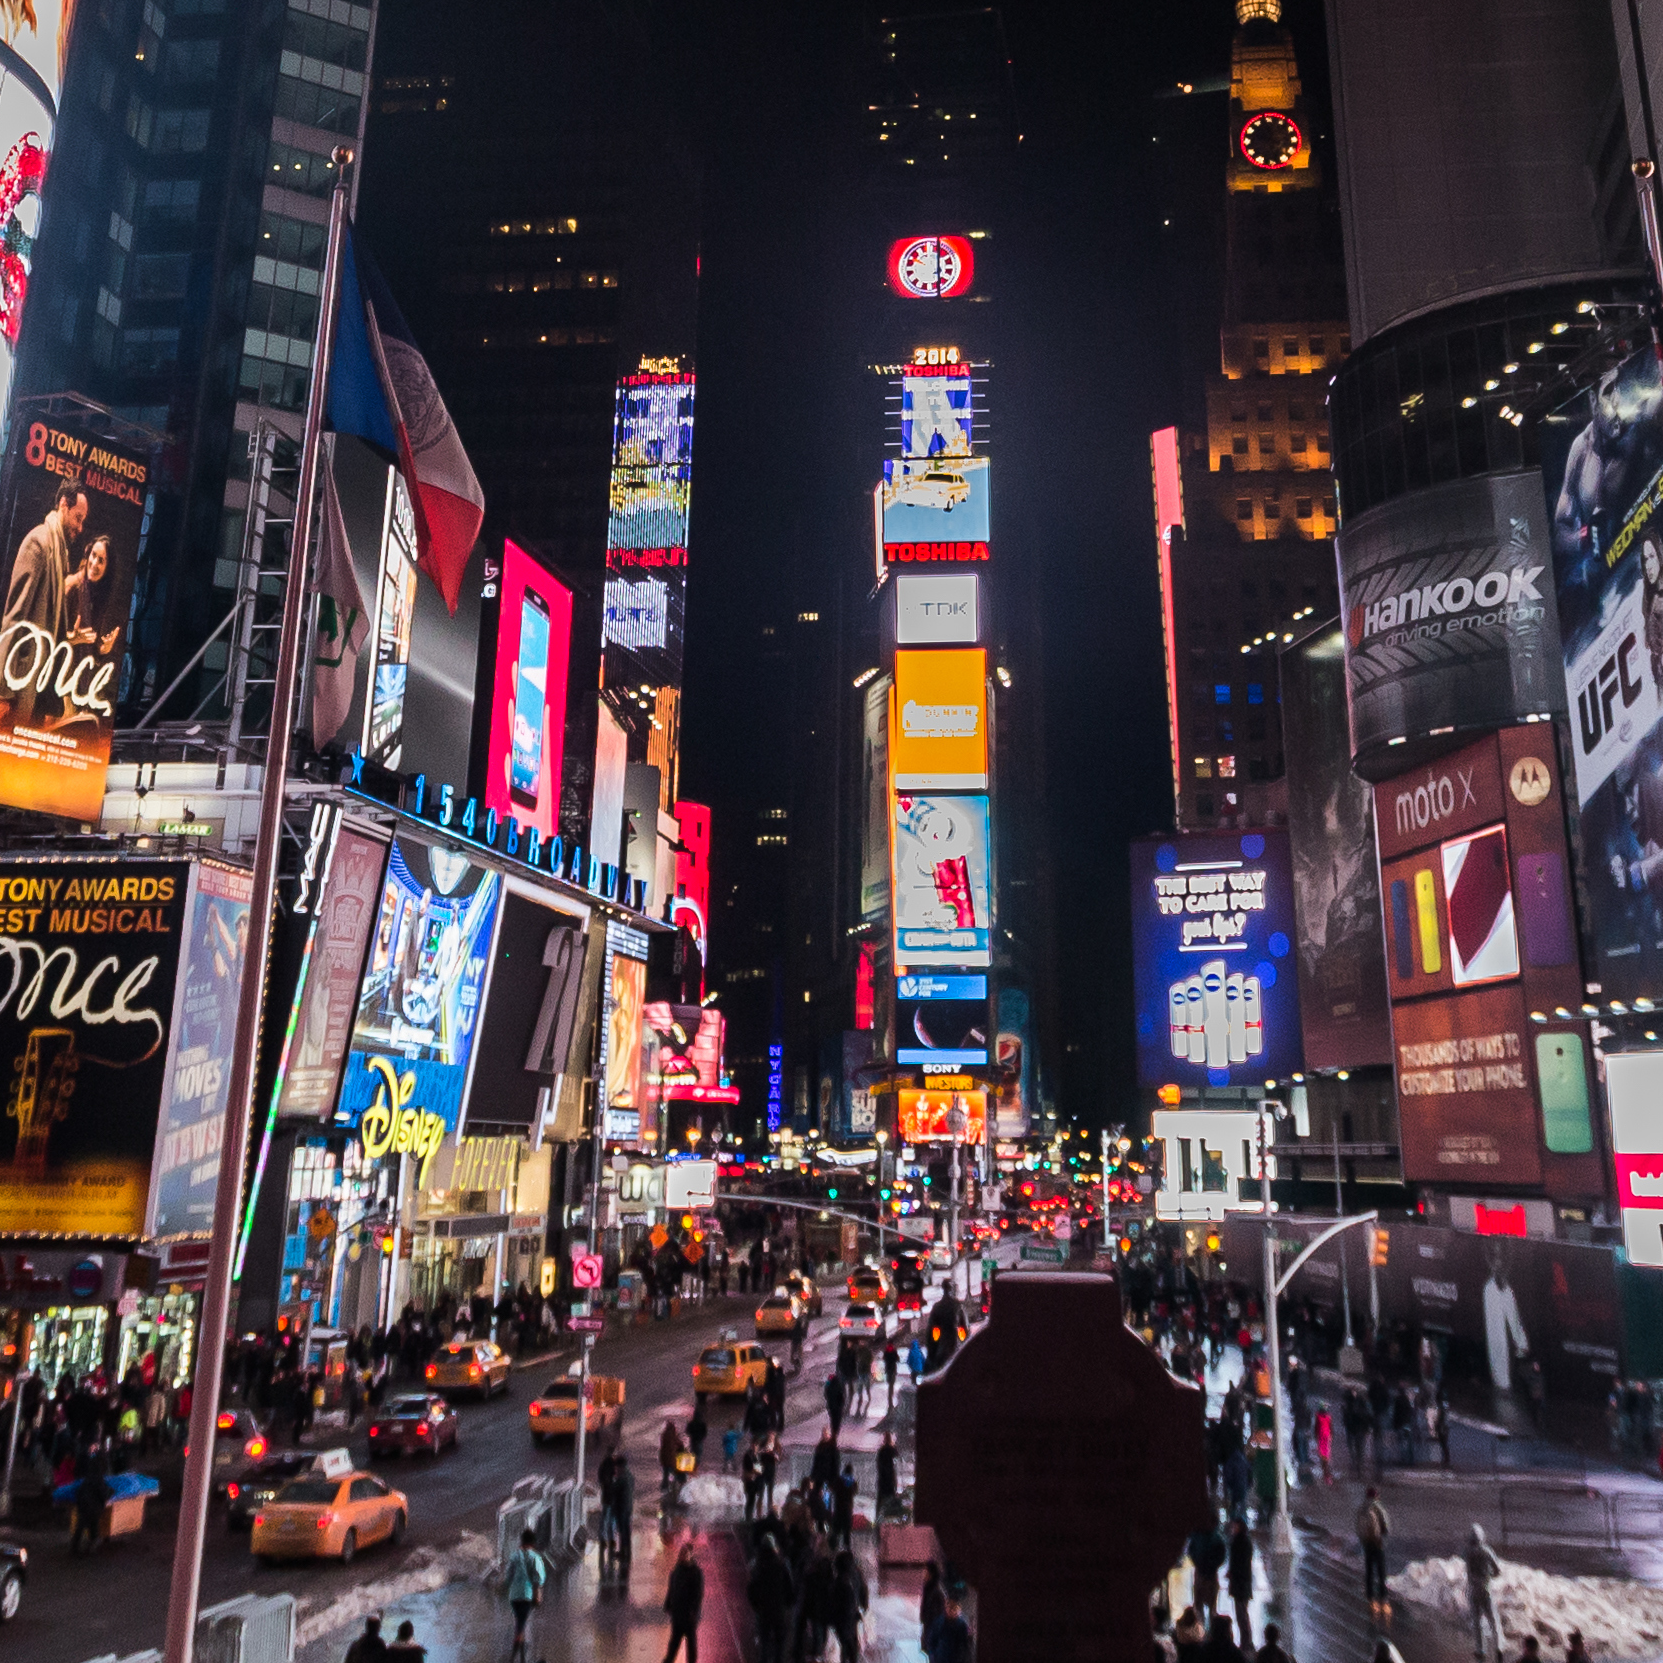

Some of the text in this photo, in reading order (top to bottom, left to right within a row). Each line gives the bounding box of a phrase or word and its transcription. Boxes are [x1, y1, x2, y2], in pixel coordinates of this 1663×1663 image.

[904, 365, 970, 376] TOSHIBA
[914, 350, 958, 365] 2014
[25, 422, 147, 483] 8 TONY AWARDS
[45, 456, 143, 506] BEST MUSICAL
[885, 542, 990, 562] TOSHIBA
[920, 601, 968, 616] TDK
[1385, 604, 1545, 650] driving emotion
[1577, 631, 1643, 757] UFC
[414, 772, 498, 847] 1540
[1395, 768, 1477, 835] moto X
[162, 824, 210, 836] LAMAR
[63, 876, 175, 902] AWARDS
[1155, 878, 1186, 895] THE
[1228, 872, 1266, 891] WAY
[1159, 896, 1182, 914] TO
[48, 908, 170, 933] MUSICAL
[1400, 1041, 1459, 1067] THOUSANDS
[1460, 1039, 1474, 1061] OF
[1504, 1033, 1520, 1056] TO
[175, 1058, 223, 1104] MOVES
[923, 1064, 962, 1073] SONY
[1400, 1067, 1485, 1096] CUSTOMIZE YOUR
